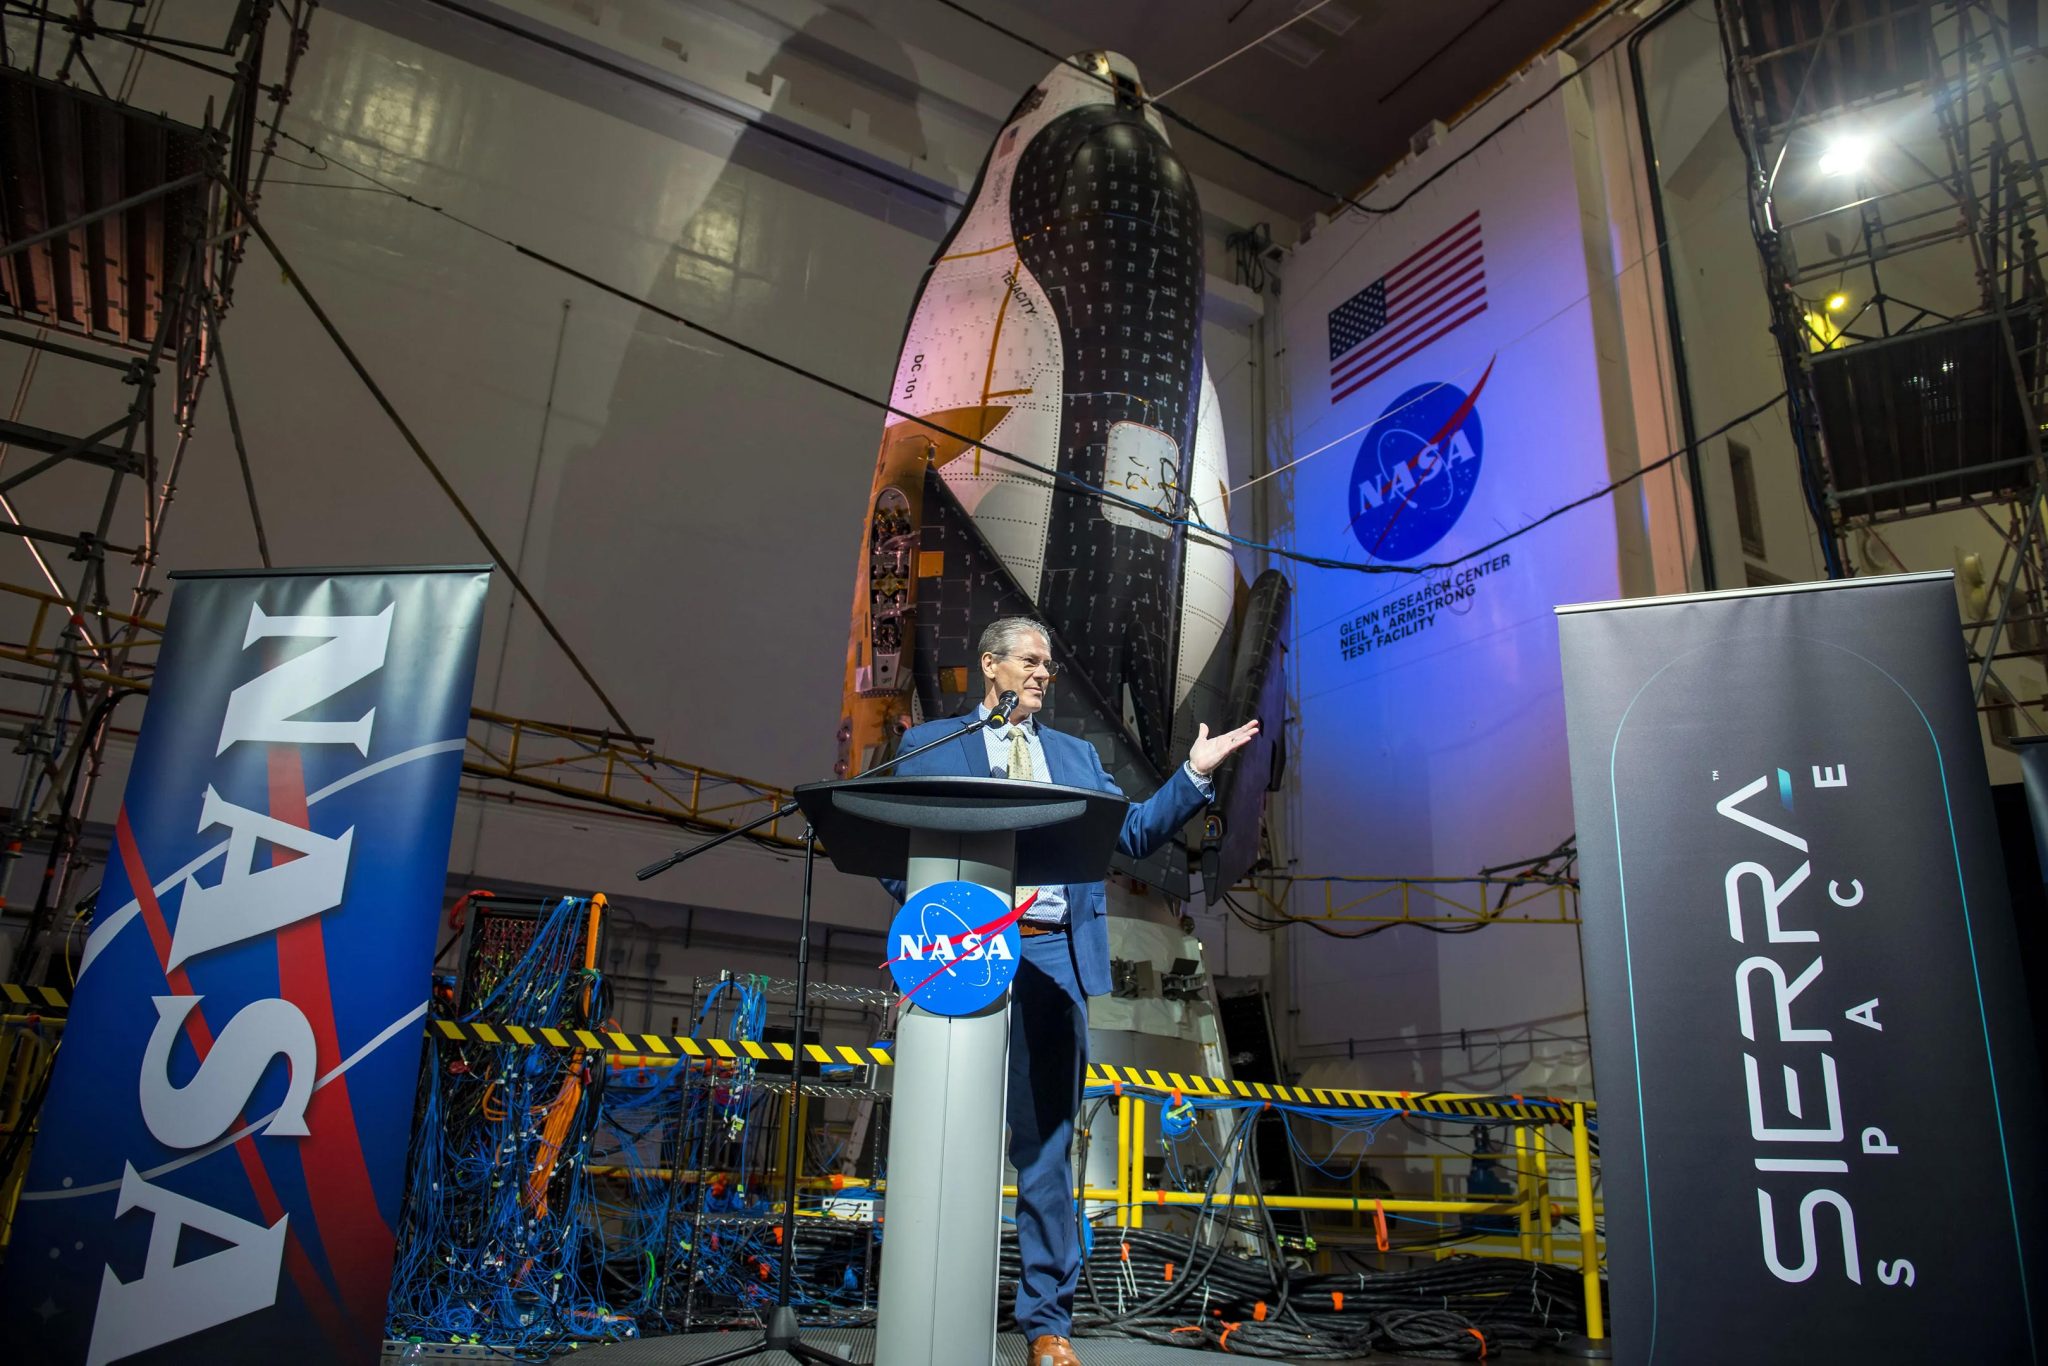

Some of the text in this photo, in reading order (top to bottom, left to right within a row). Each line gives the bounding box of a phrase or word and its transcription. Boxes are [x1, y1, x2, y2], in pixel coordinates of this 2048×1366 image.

[1001, 270, 1038, 314] TENACITY
[903, 354, 925, 400] DC-101
[1358, 429, 1476, 515] NASA
[1340, 553, 1511, 637] GLENN RESEARCH CENTER
[1340, 584, 1476, 649] NEIL A. ARMSTRONG
[1342, 613, 1436, 661] TEST FACILITY
[86, 601, 395, 1366] NASA
[898, 933, 1014, 961] NASA
[1716, 767, 1862, 1286] SIERRA
[1811, 763, 1916, 1288] SPACE
